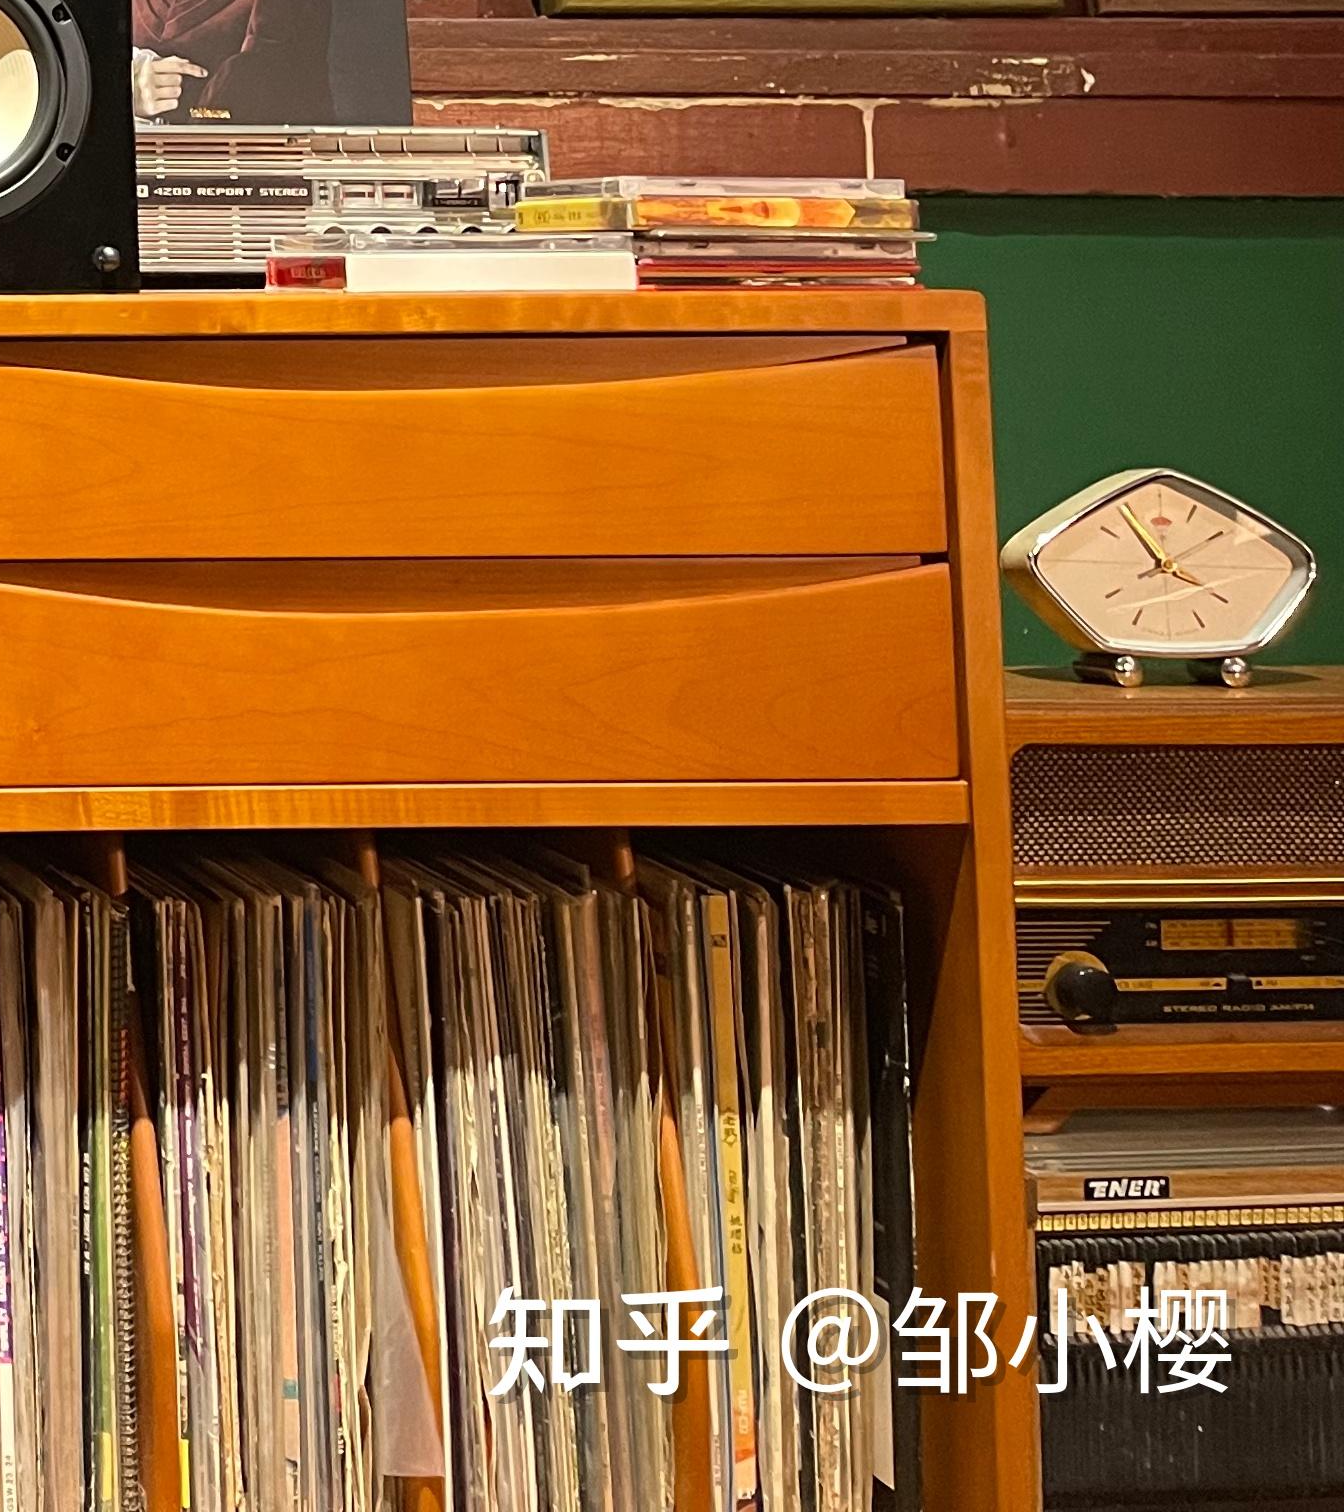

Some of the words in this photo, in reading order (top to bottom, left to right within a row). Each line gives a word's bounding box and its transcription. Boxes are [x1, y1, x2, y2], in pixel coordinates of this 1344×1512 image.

[196, 187, 253, 196] REPORT
[259, 187, 309, 197] STEREO
[1222, 1004, 1266, 1013] RADIO
